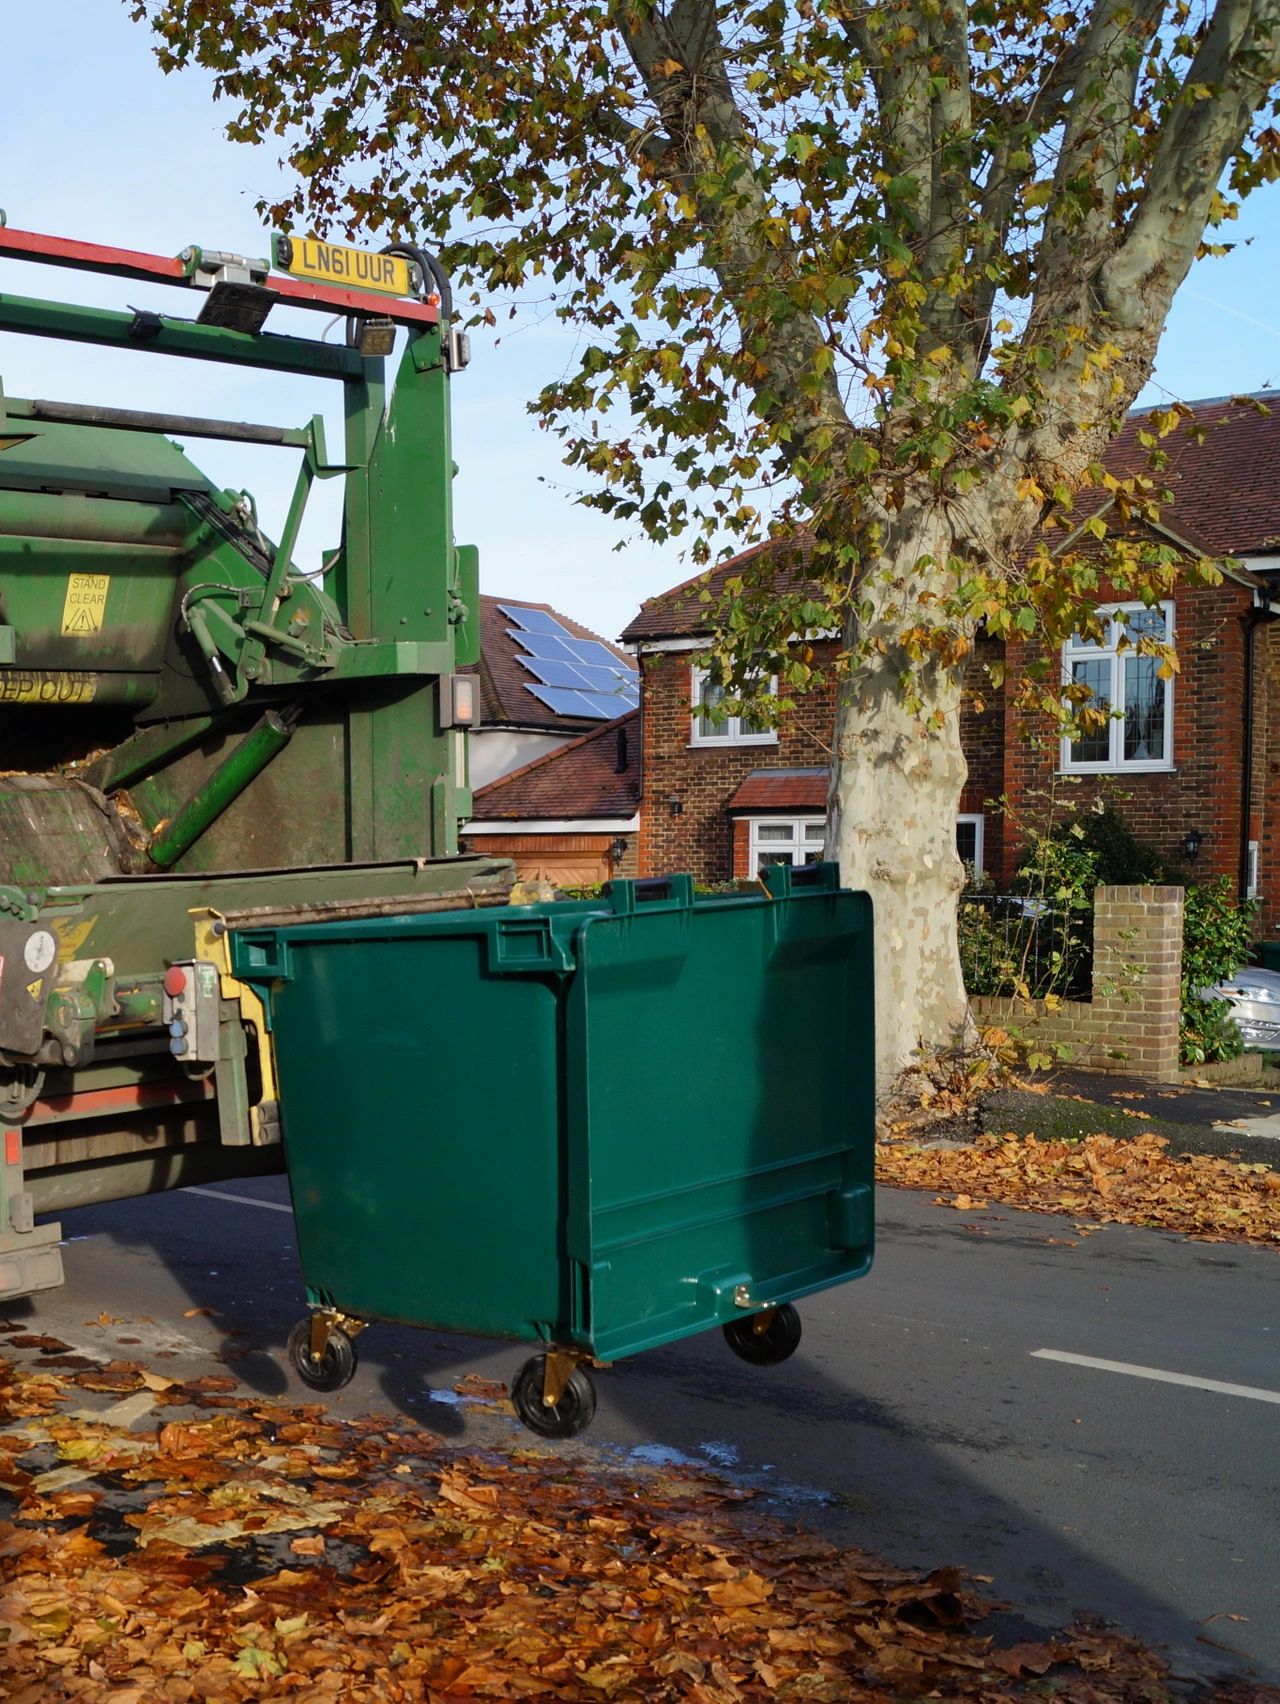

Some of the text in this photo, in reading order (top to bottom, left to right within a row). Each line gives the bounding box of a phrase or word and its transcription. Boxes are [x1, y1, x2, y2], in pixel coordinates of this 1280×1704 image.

[302, 241, 395, 286] LN61 UUR
[73, 578, 106, 590] STAND
[70, 593, 104, 604] CLEAR
[39, 678, 93, 701] OUT
